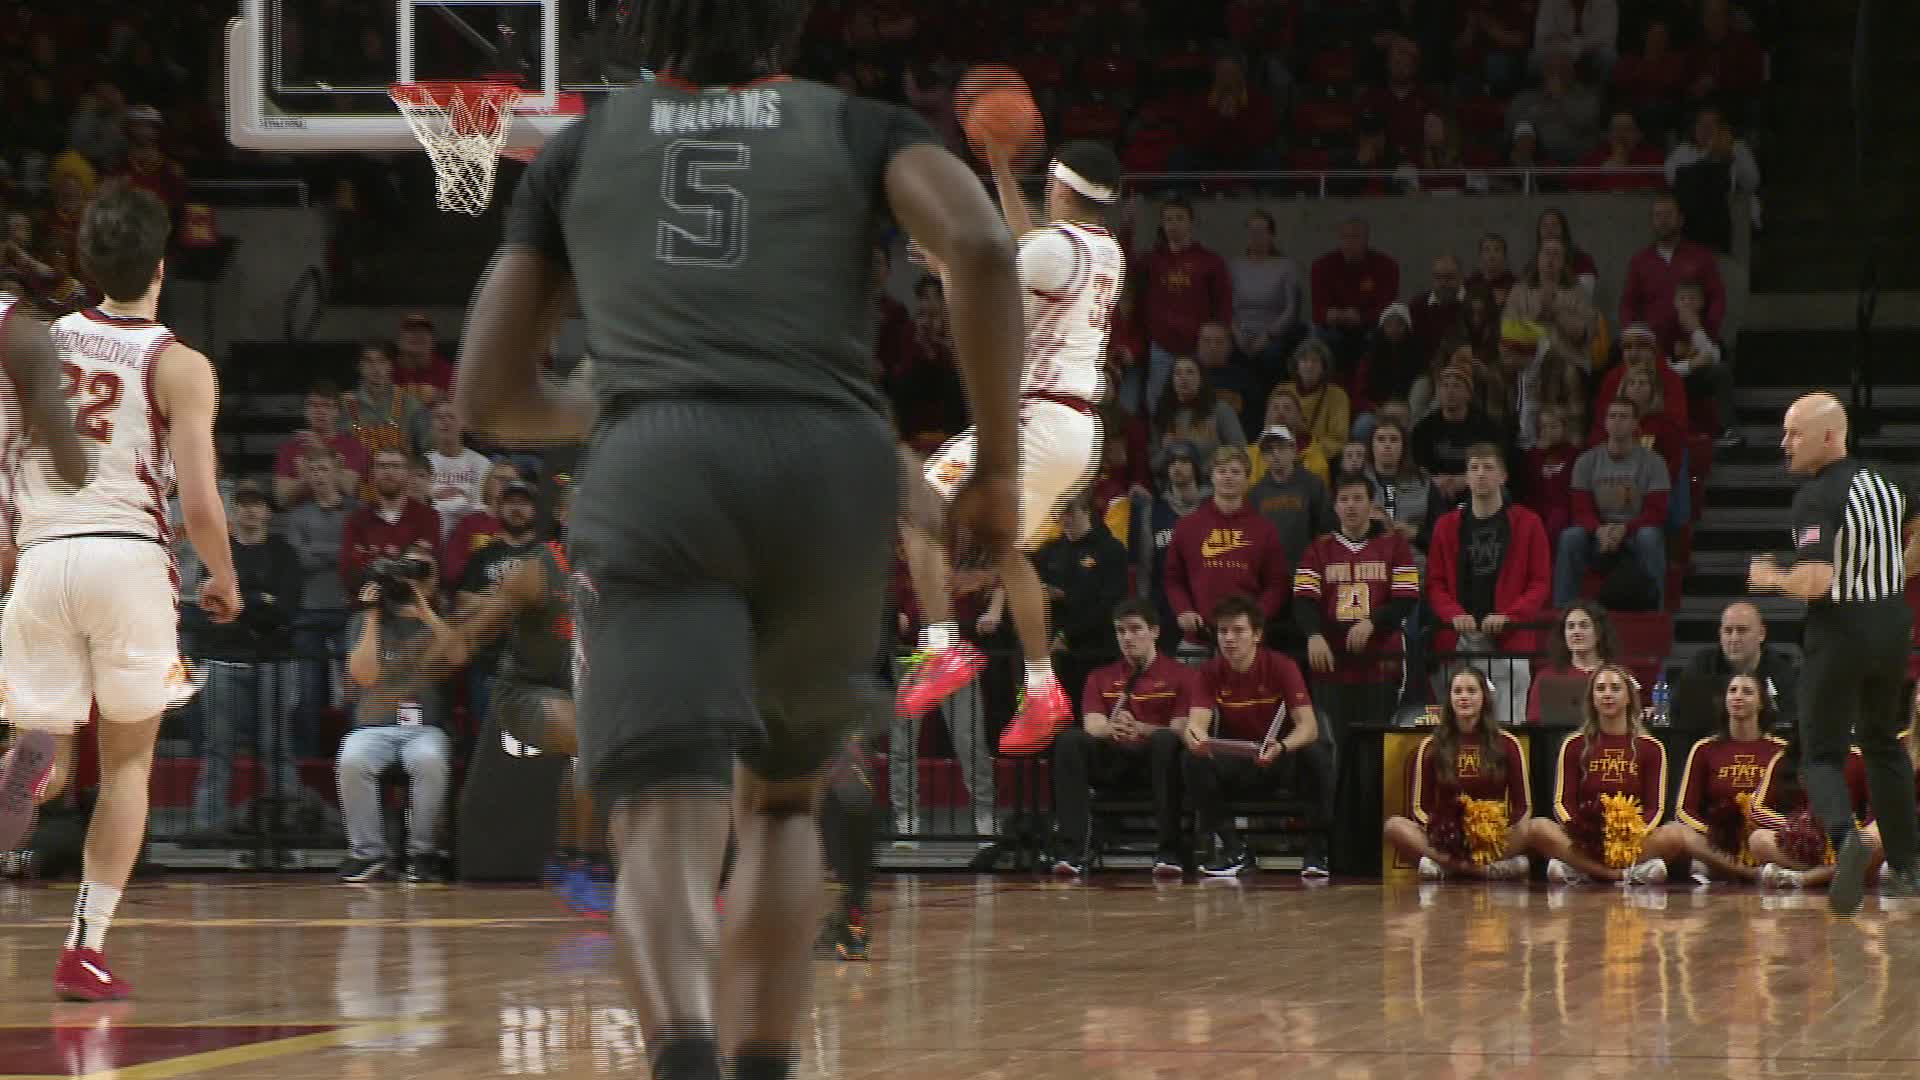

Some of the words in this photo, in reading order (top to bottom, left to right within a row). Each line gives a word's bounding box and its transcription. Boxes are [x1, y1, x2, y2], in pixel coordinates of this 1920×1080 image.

[650, 88, 781, 135] WILLIAMS
[656, 138, 750, 268] 5
[1588, 758, 1639, 777] STATE
